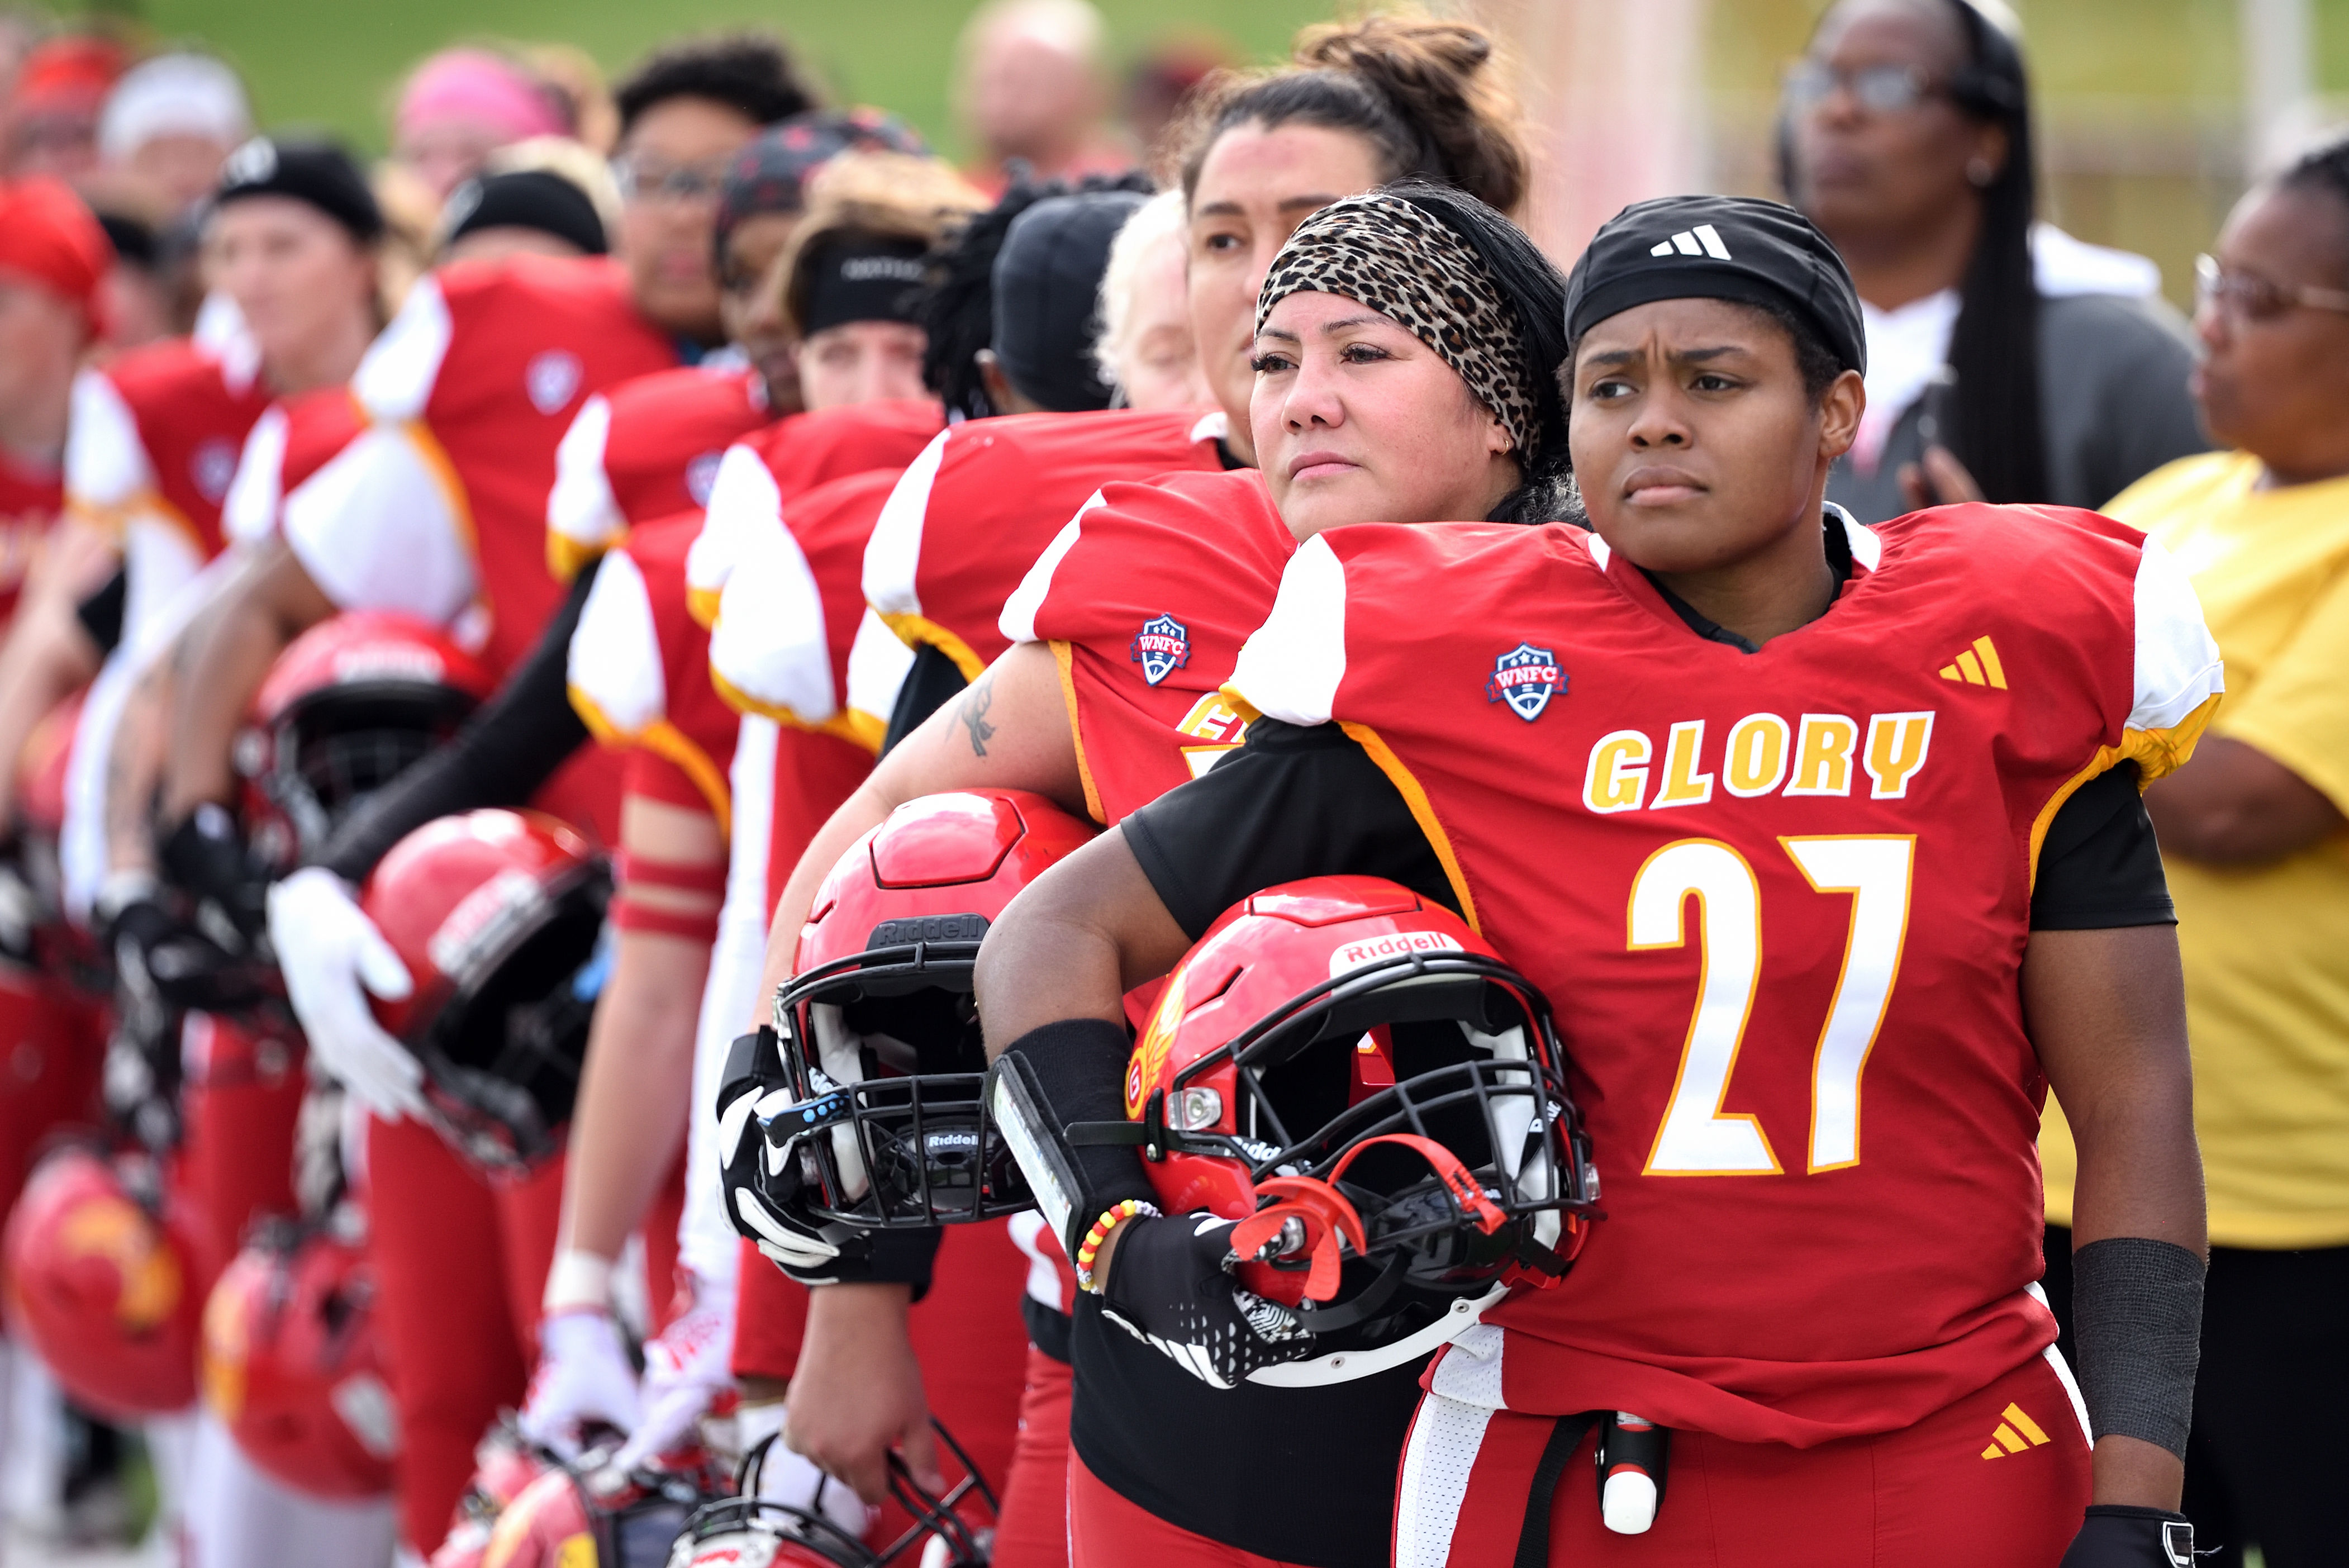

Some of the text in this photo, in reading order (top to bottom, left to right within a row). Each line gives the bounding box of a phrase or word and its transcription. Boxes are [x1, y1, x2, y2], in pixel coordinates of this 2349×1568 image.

[1139, 635, 1185, 655] WNFC
[1495, 666, 1557, 688] WNFC
[1582, 710, 1936, 814] GLORY
[879, 916, 979, 945] Riddell
[1344, 932, 1448, 963] Riddell
[1627, 834, 1917, 1176] 27
